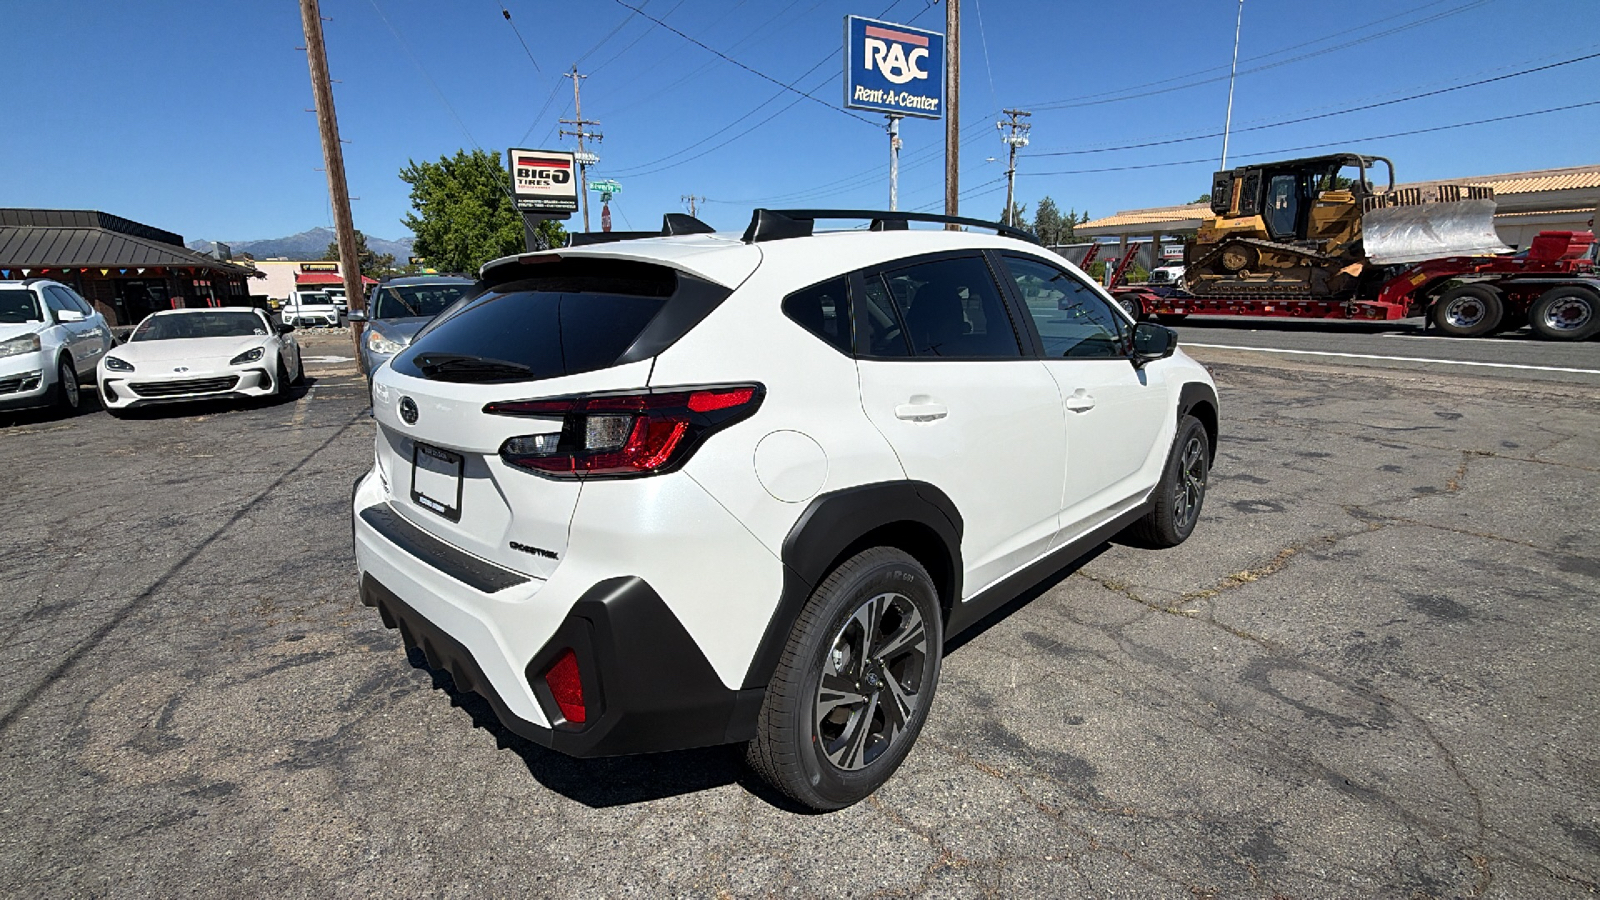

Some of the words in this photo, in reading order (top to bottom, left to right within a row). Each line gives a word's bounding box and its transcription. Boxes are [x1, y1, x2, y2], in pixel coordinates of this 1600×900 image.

[864, 38, 929, 84] RAC
[517, 168, 551, 179] BIG
[517, 178, 551, 186] TIRES
